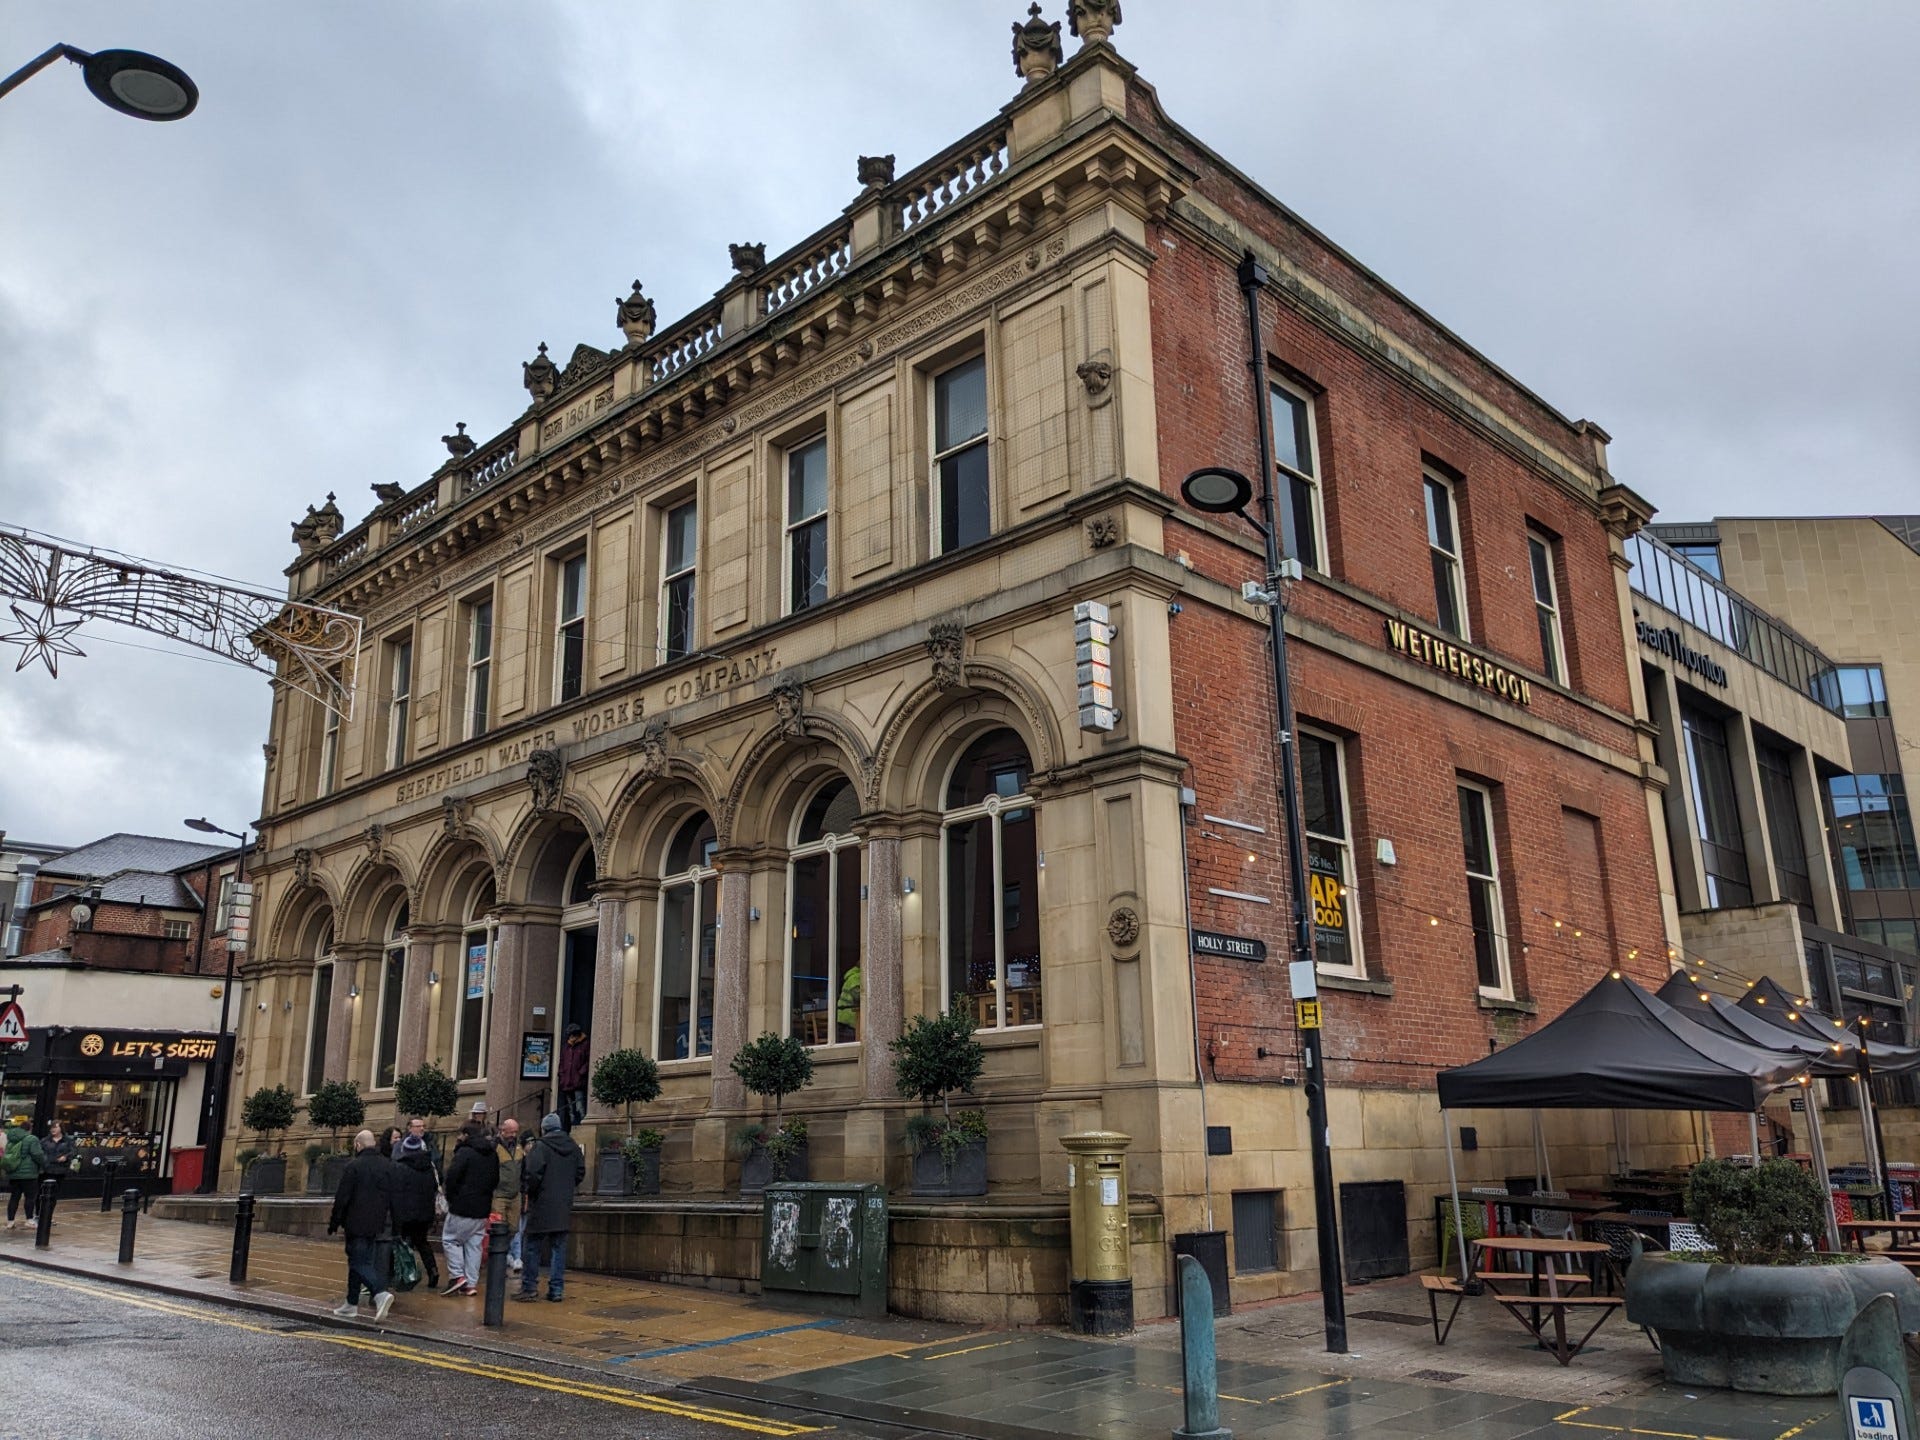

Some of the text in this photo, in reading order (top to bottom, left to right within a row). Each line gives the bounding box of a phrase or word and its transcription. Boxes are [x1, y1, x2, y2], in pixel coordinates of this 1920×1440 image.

[1387, 619, 1532, 706] WETHERSPOON
[1669, 630, 1728, 689] Thornton
[397, 757, 484, 802] SHEFFIELD
[499, 730, 557, 766] WATER
[572, 697, 645, 737] WORKS
[1198, 935, 1254, 955] HOLLY STREET
[1301, 1004, 1318, 1025] H
[112, 1041, 163, 1058] LET'S
[167, 1043, 216, 1059] SUSHI
[1098, 1235, 1122, 1252] GR
[1857, 1429, 1894, 1440] Loading
